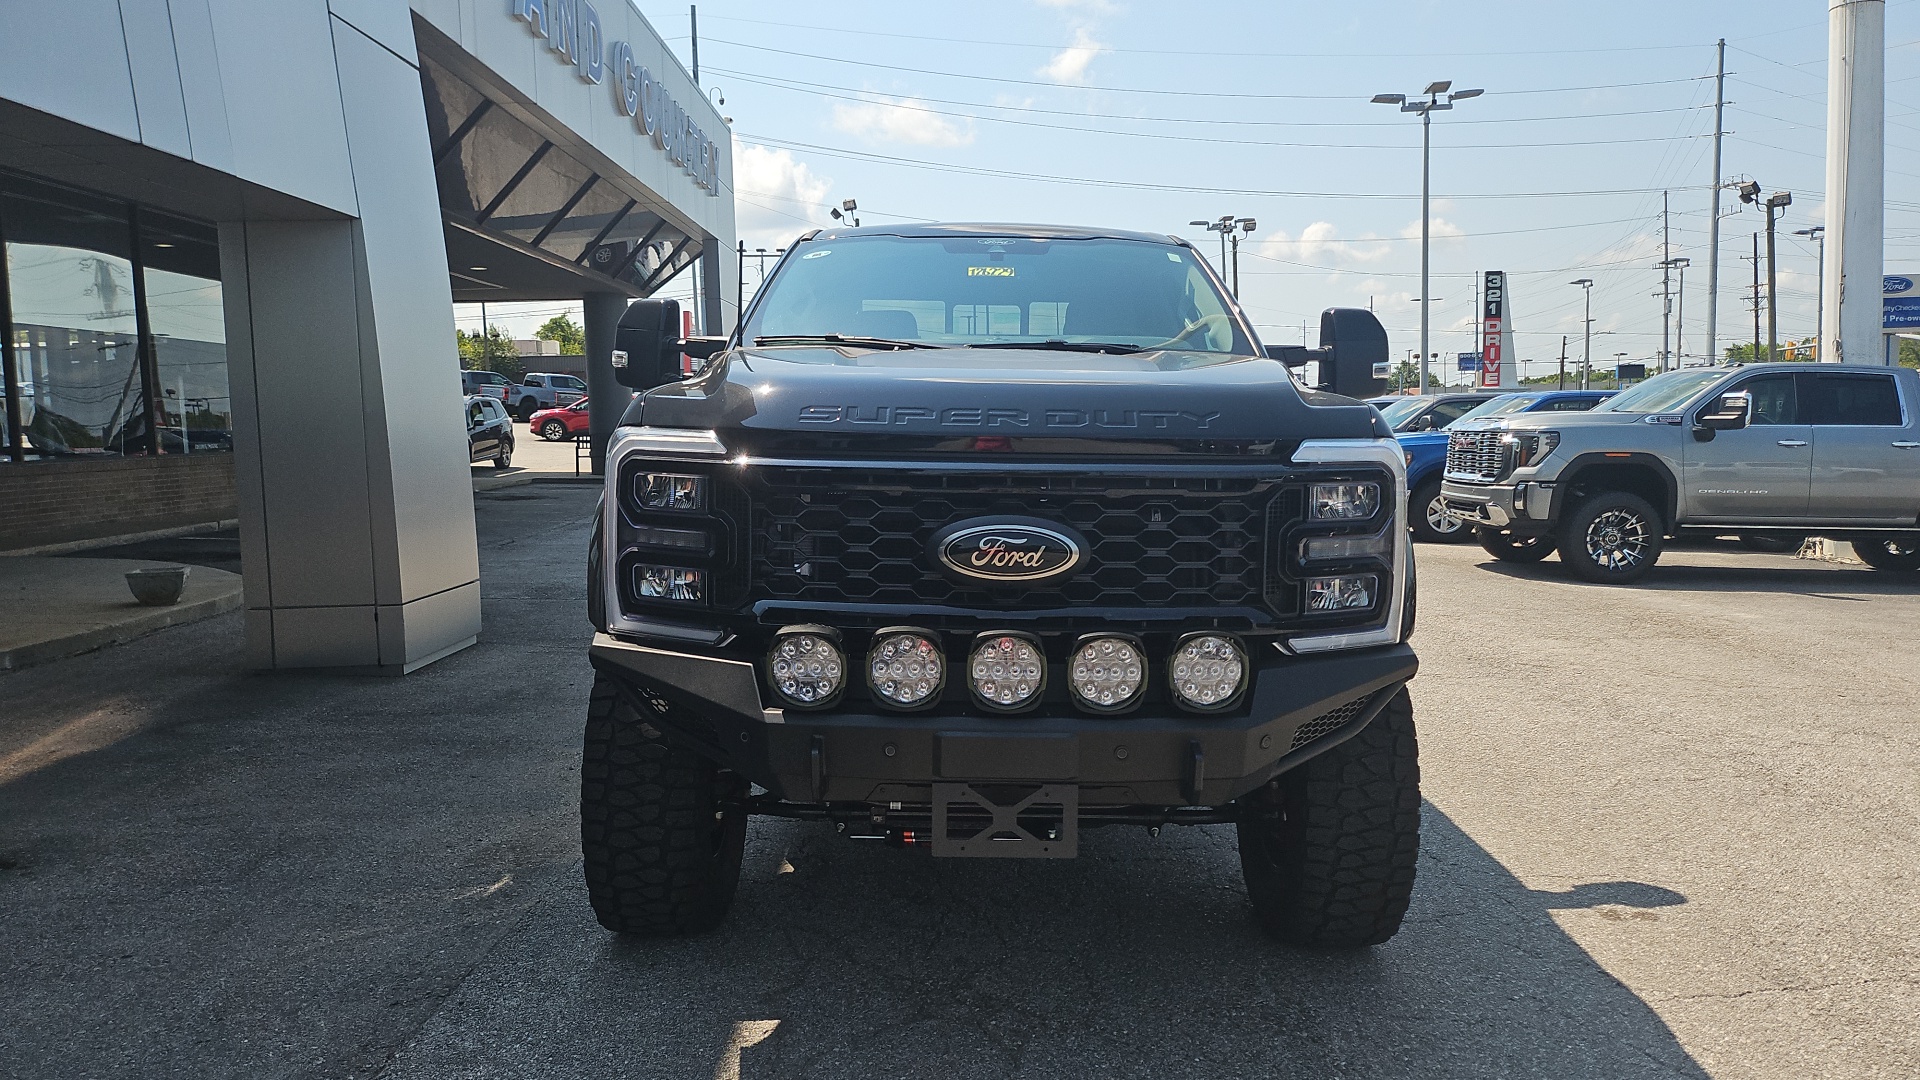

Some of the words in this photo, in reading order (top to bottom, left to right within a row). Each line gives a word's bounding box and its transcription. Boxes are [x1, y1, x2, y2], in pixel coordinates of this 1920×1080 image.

[614, 41, 720, 197] COUNTRY
[1487, 275, 1502, 315] 321
[1883, 280, 1906, 291] Ford
[1484, 321, 1500, 385] DRIVE
[799, 405, 1029, 427] SUPER
[1045, 409, 1221, 429] DUTY
[970, 536, 1047, 567] Ford
